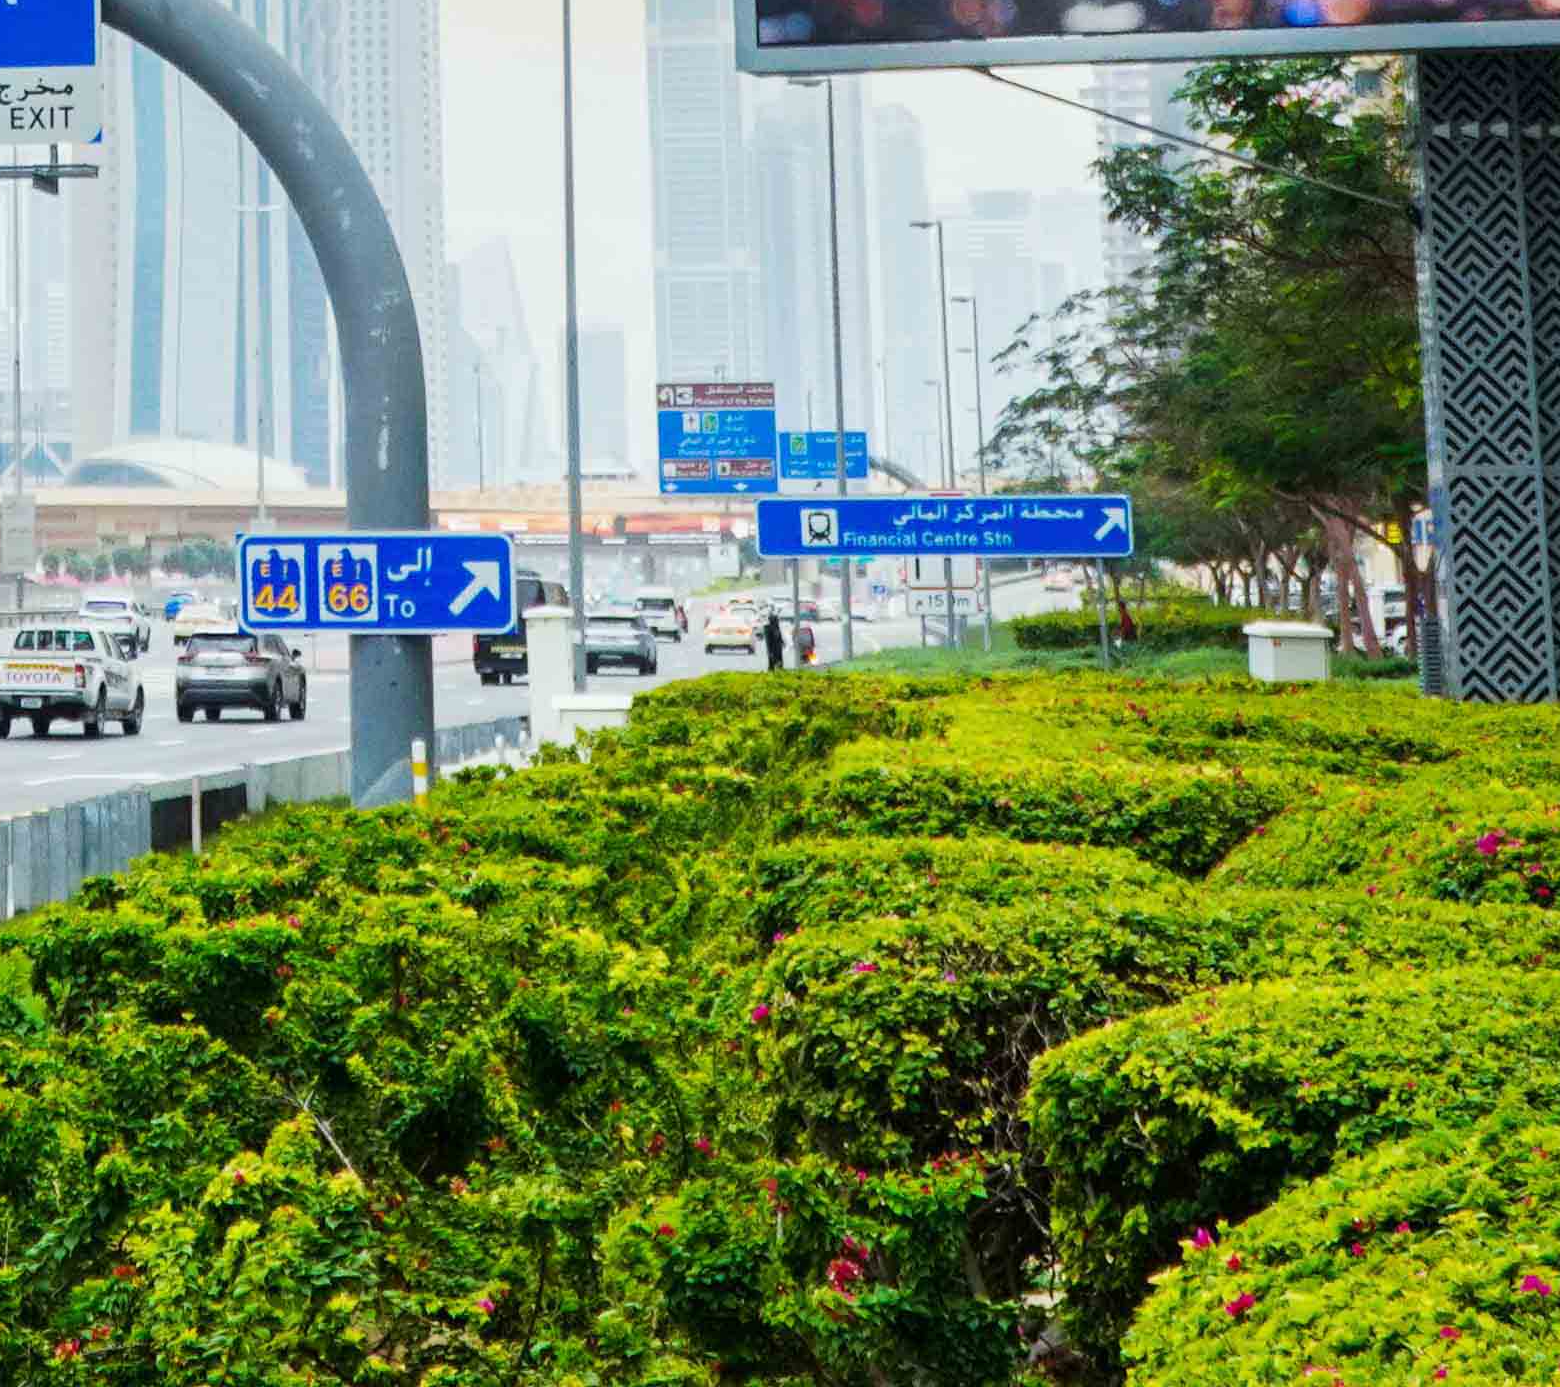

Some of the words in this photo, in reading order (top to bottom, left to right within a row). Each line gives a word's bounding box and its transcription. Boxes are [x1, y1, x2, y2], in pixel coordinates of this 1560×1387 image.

[10, 107, 75, 131] EXIT
[893, 504, 947, 526] المالي
[953, 504, 1013, 524] المركز
[1021, 505, 1084, 520] محطة
[843, 531, 917, 547] Financial
[922, 531, 977, 547] Centre
[983, 530, 1013, 546] Stn
[386, 546, 433, 587] إلى
[255, 584, 299, 613] 44
[328, 583, 370, 613] 66
[384, 594, 416, 619] To
[6, 673, 62, 683] TOYOTA
